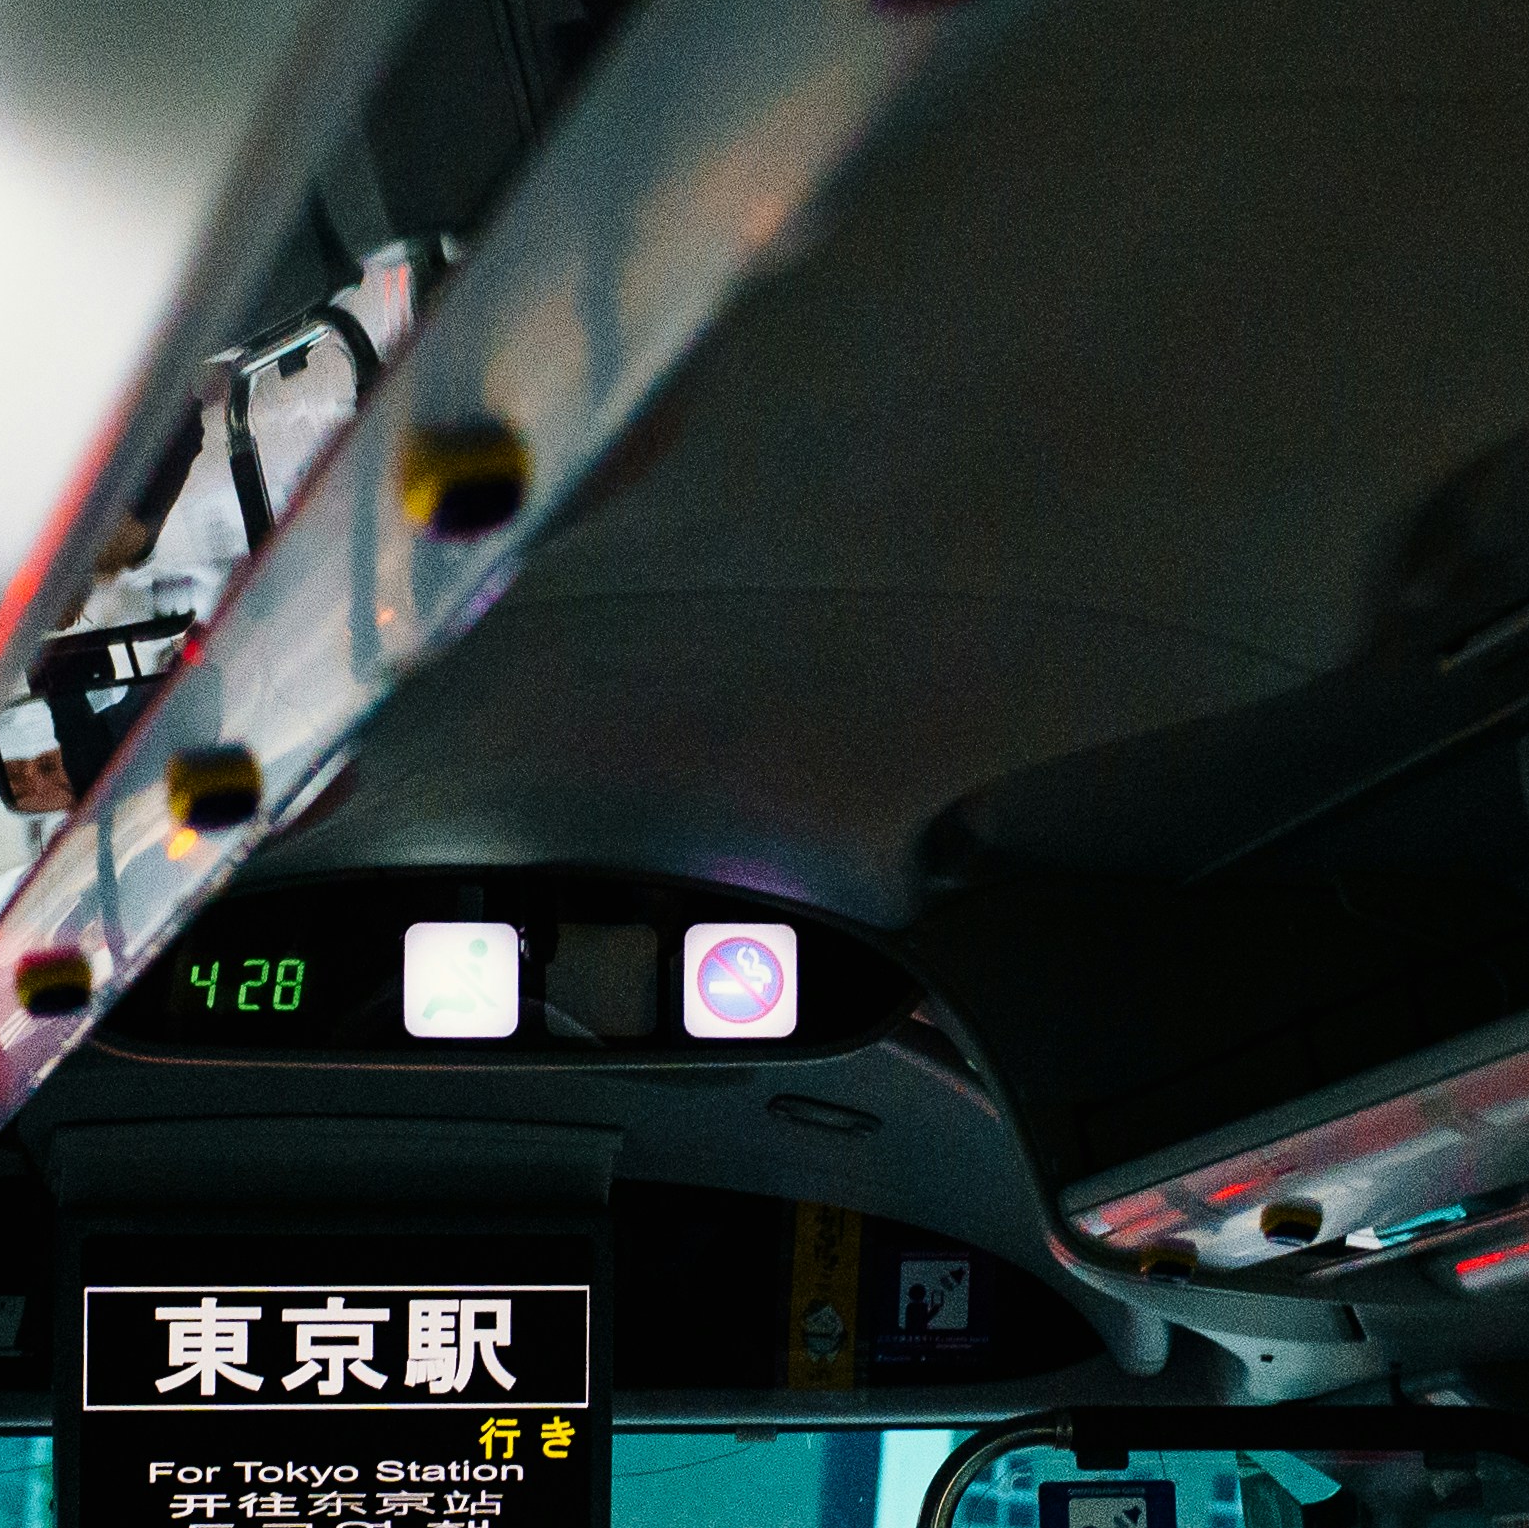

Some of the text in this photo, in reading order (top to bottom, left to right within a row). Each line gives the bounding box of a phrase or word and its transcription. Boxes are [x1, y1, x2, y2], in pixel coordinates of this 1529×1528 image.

[154, 1297, 517, 1396] 東京駅
[478, 1416, 576, 1460] 行き
[149, 1459, 524, 1488] For Tokyo Station
[169, 1491, 503, 1518] 开往东京站
